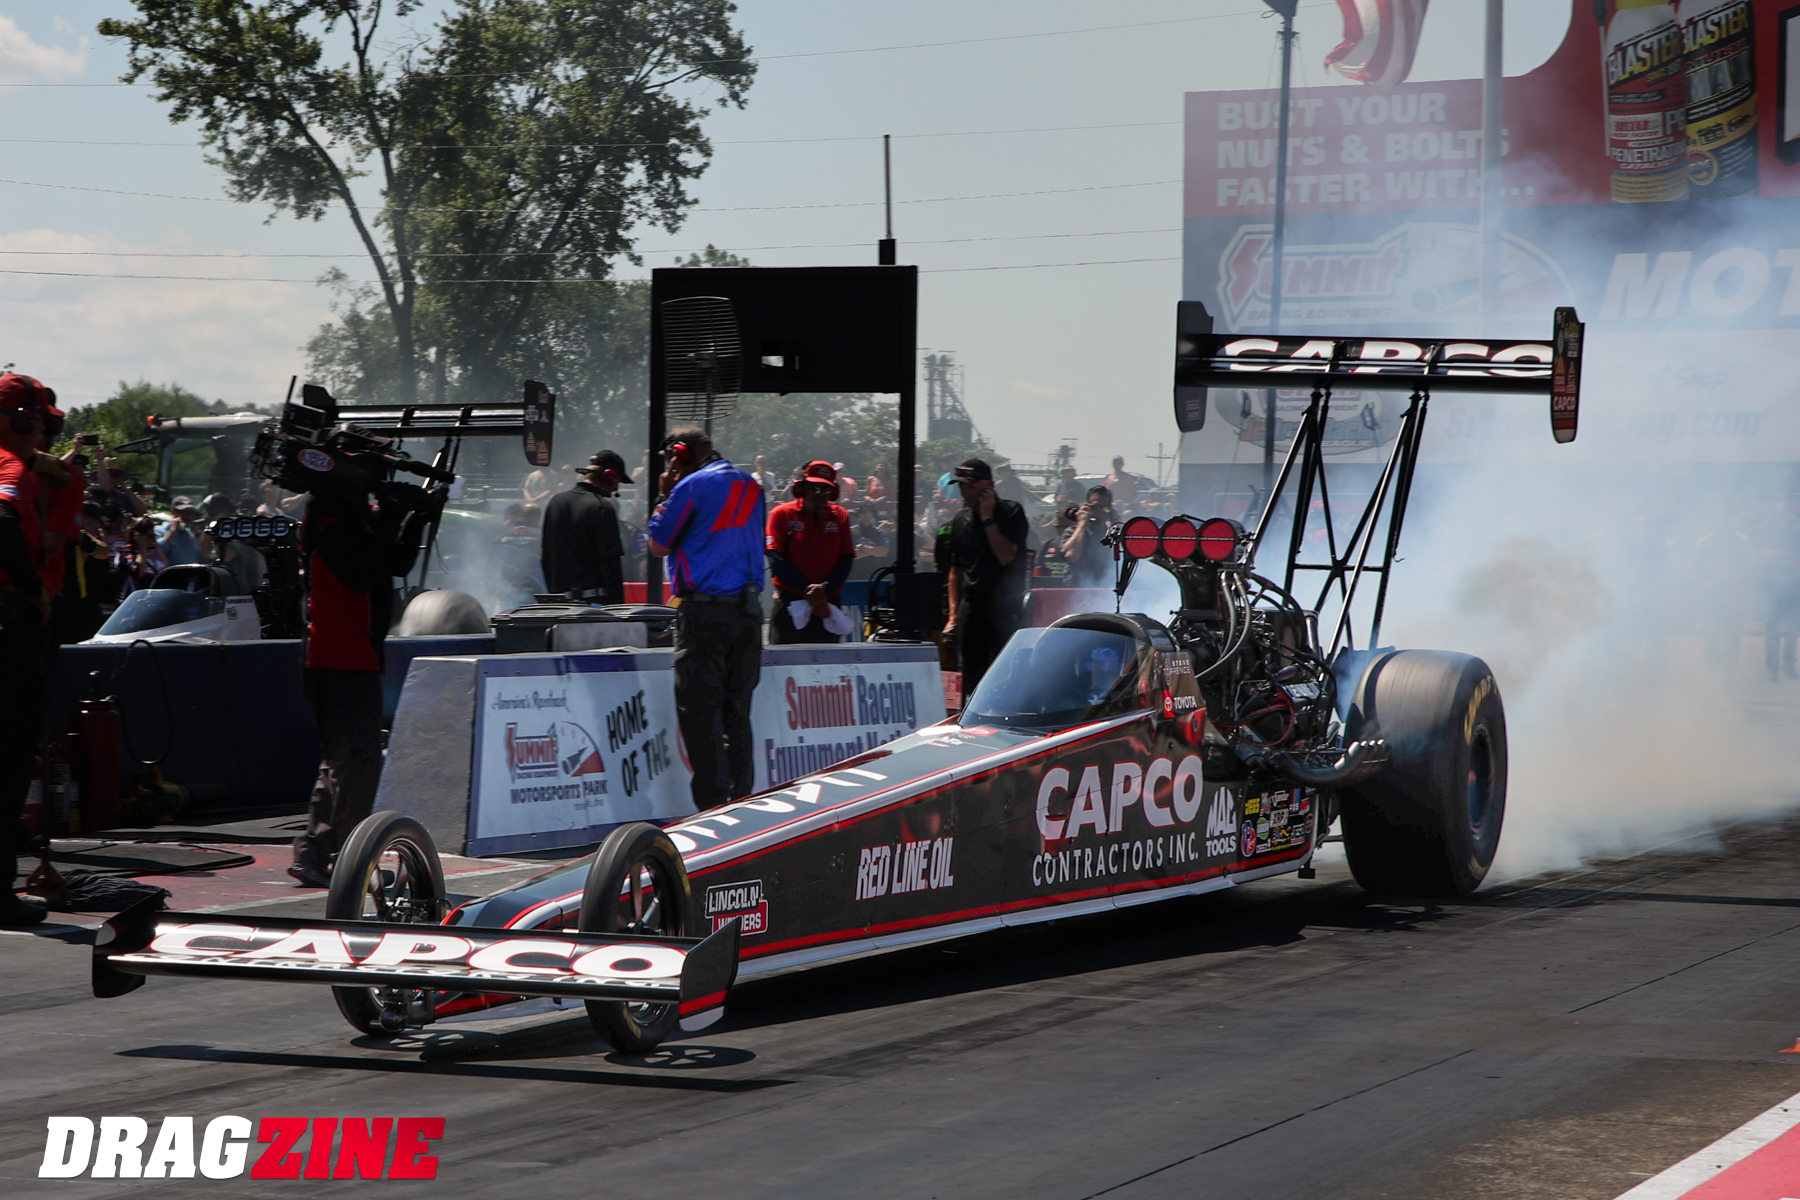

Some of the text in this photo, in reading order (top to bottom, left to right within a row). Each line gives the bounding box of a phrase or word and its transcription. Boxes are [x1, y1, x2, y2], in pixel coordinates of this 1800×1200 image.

[1217, 92, 1448, 131] BUST YOUR
[1216, 135, 1326, 169] NUTS
[1339, 134, 1371, 164] &
[1216, 173, 1371, 207] FASTER
[1248, 307, 1392, 321] RANG EQUIPMENT
[1224, 337, 1554, 378] CAPCO
[1323, 440, 1373, 448] EAGUE
[1171, 659, 1190, 667] STEVE
[785, 673, 917, 731] Summit Racing
[1173, 696, 1198, 710] TOYOTA
[605, 689, 648, 753] HOME
[620, 727, 671, 798] OF THE
[509, 779, 609, 804] MOTORSPORTS PARK
[1035, 753, 1203, 841] CAPCO
[1206, 786, 1238, 838] MAC
[1032, 832, 1199, 887] CONTRACTORS INC.
[1205, 835, 1237, 858] TOOLS
[855, 837, 955, 900] RED LINE OIL
[708, 886, 760, 913] LINCOLN
[717, 912, 762, 932] WERS
[149, 921, 688, 980] CAPCO
